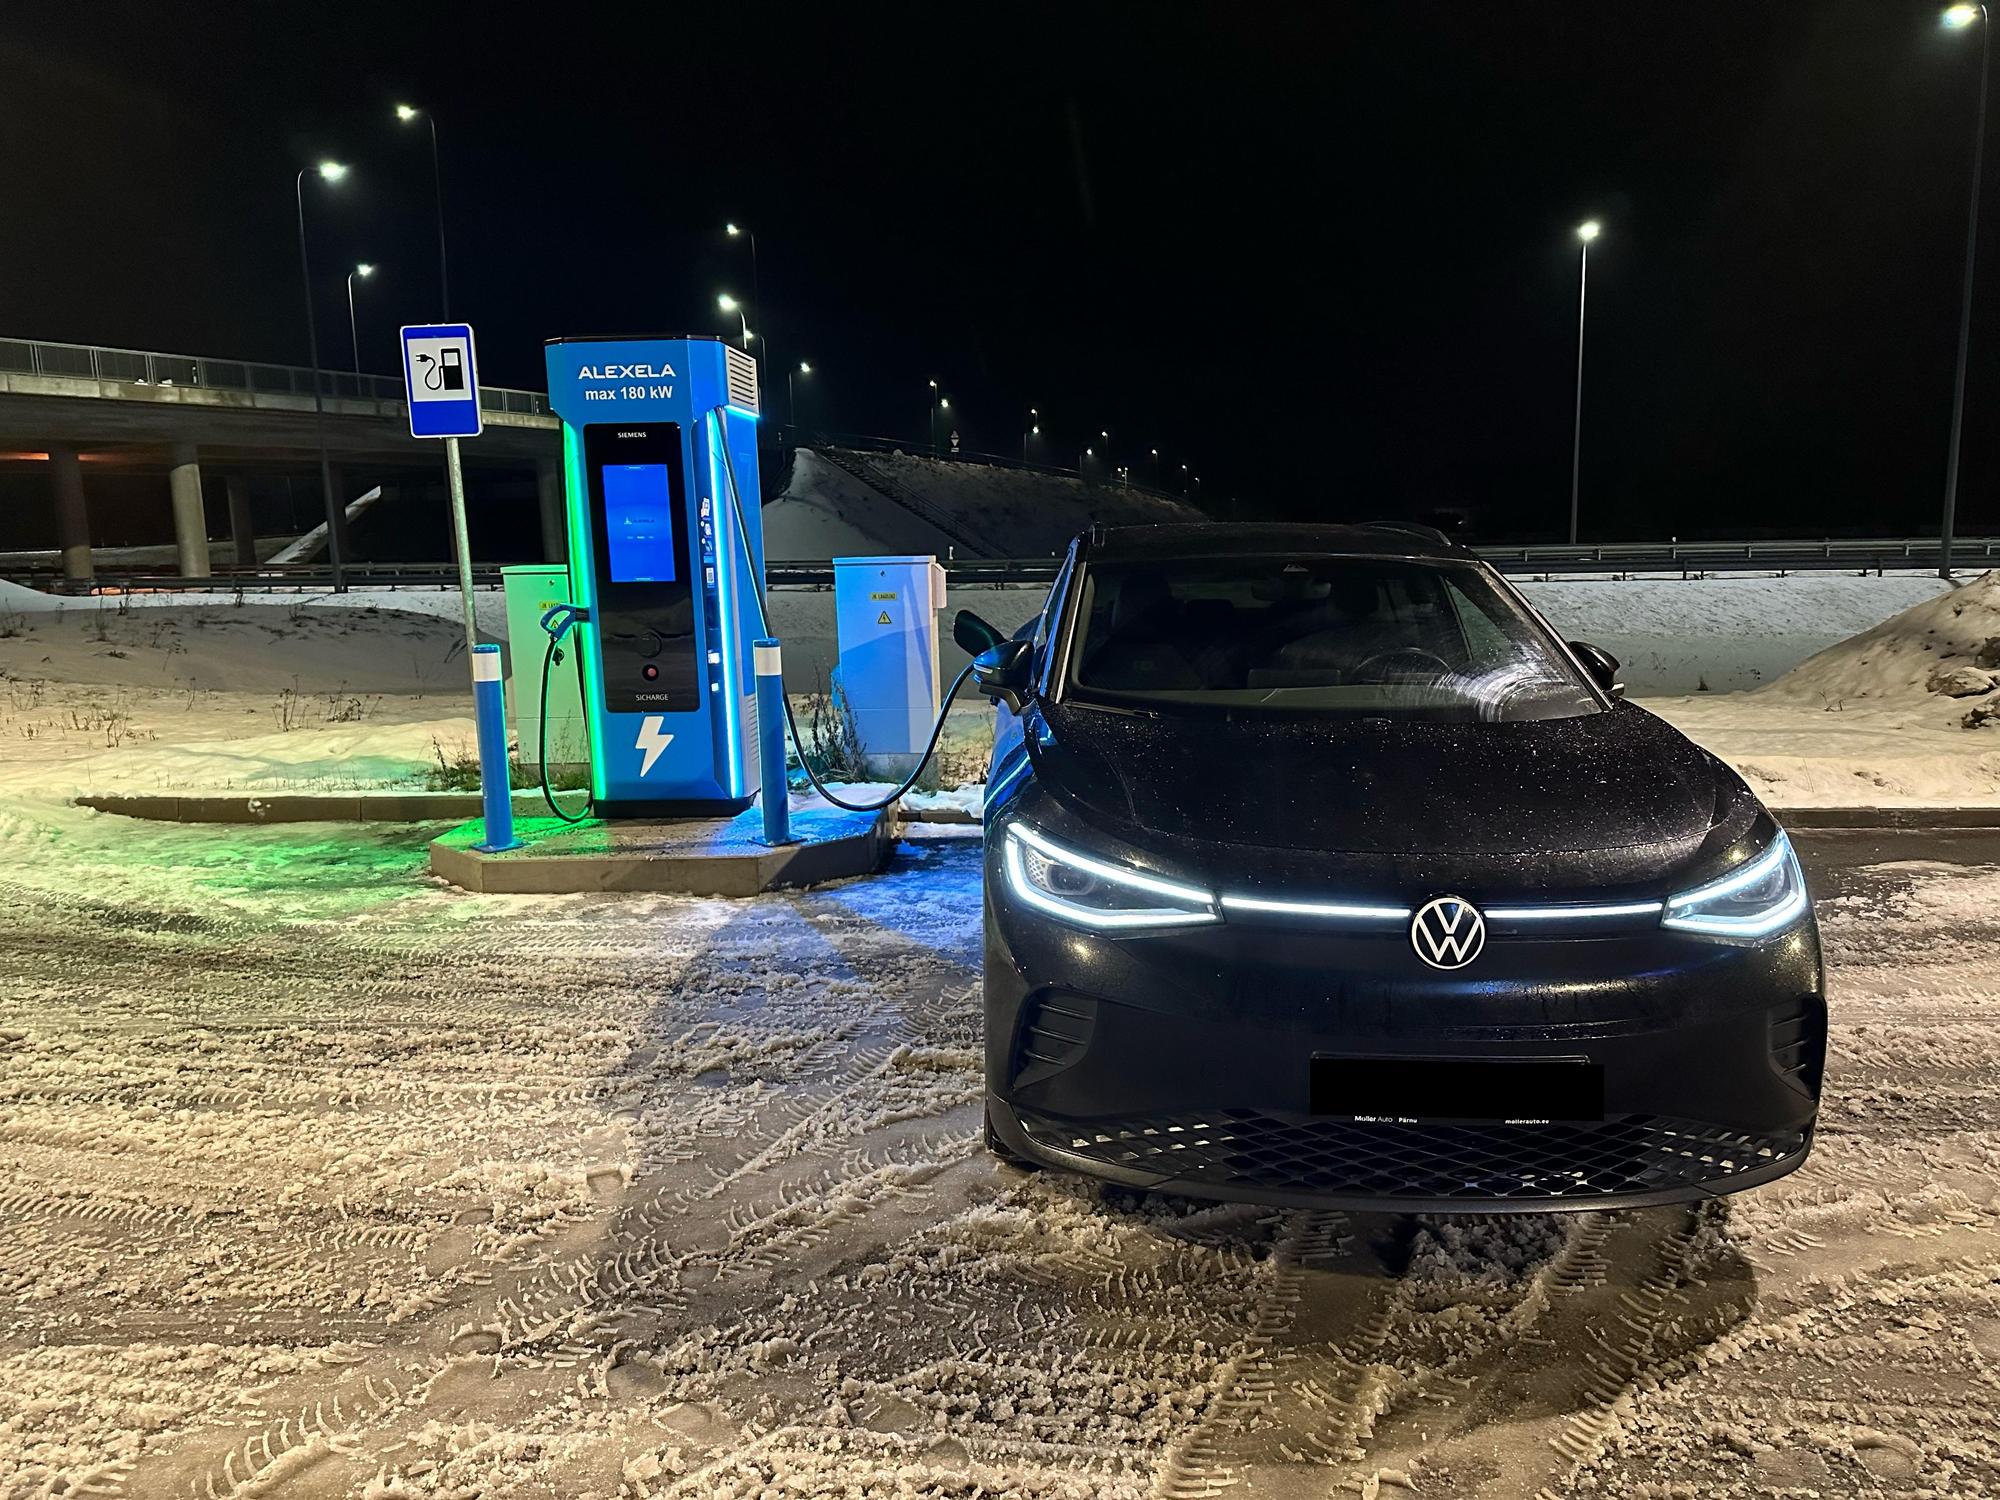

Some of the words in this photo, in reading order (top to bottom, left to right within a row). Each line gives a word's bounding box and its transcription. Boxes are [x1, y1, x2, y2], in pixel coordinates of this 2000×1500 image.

[578, 364, 676, 379] ALEXELA
[585, 389, 616, 401] max
[620, 387, 645, 400] 180
[650, 386, 673, 399] kW
